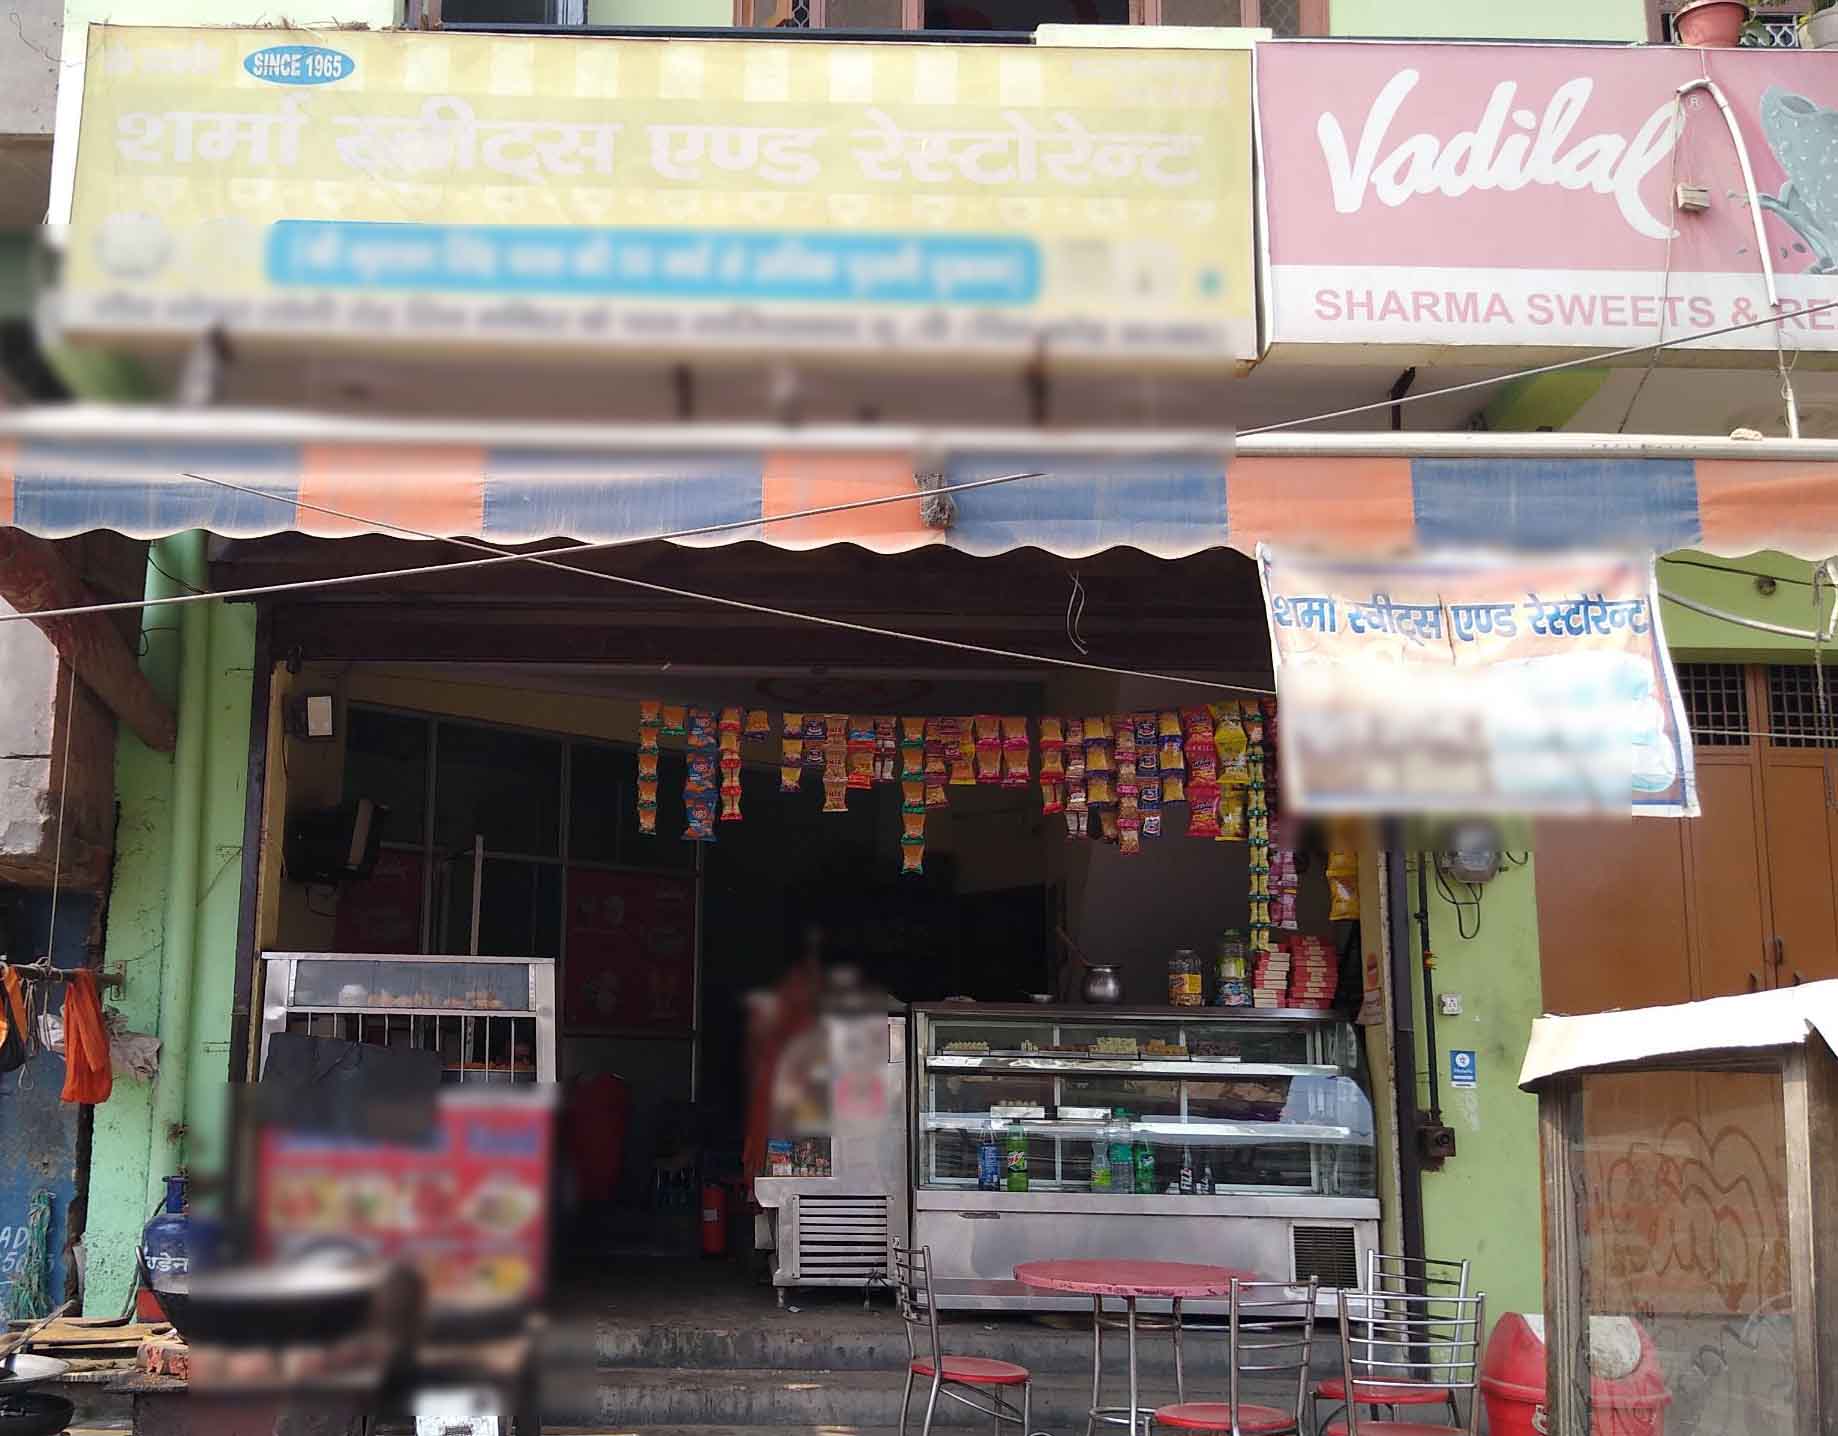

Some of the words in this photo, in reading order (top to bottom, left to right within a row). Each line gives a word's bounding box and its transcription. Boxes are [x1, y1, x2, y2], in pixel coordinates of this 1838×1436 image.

[252, 52, 301, 76] SINCE
[304, 54, 343, 77] 1965
[116, 93, 311, 169] शर्मा
[646, 125, 826, 182] एण्ड
[1317, 69, 1686, 239] Vadilal
[1314, 289, 1513, 323] SHARMA
[1527, 293, 1715, 328] SWEETS
[1731, 297, 1761, 328] &
[1450, 603, 1517, 642] एण्ड
